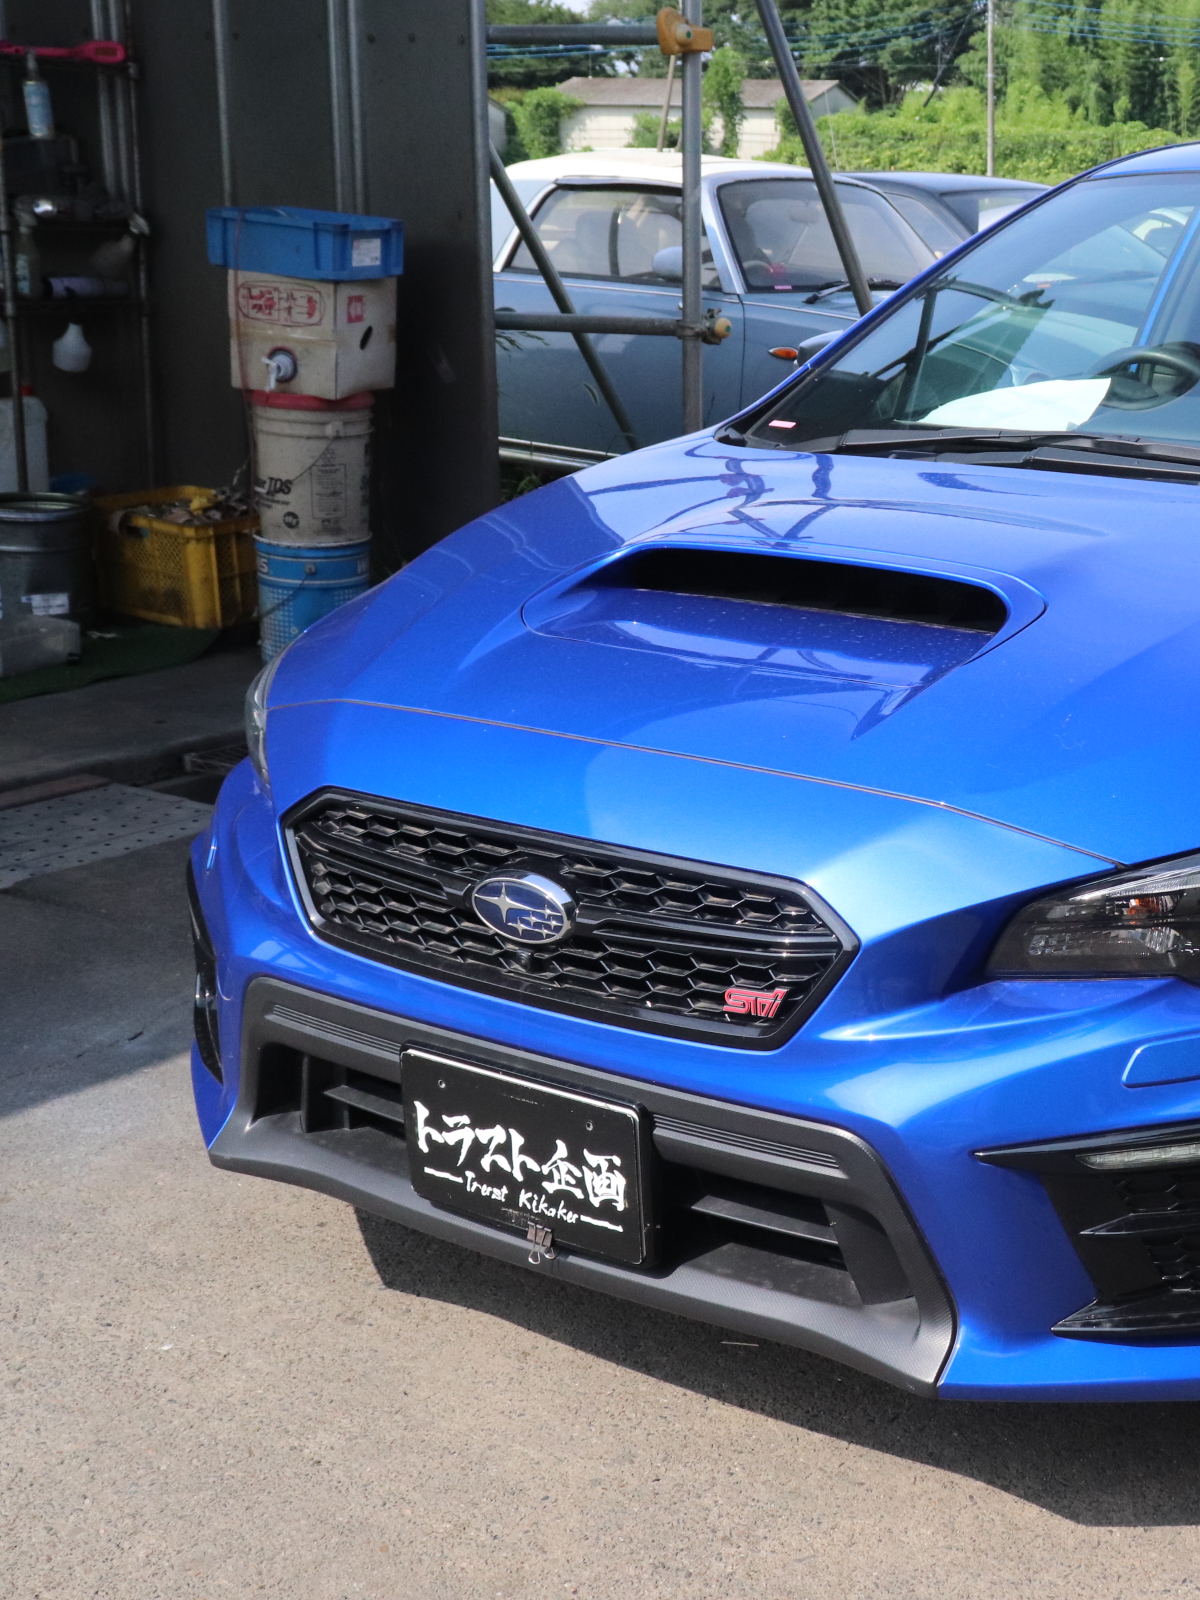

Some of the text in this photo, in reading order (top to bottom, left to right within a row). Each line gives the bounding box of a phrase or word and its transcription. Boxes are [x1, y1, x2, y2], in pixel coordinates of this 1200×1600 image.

[413, 1100, 627, 1212] トラスト企画
[465, 1170, 509, 1203] Trust
